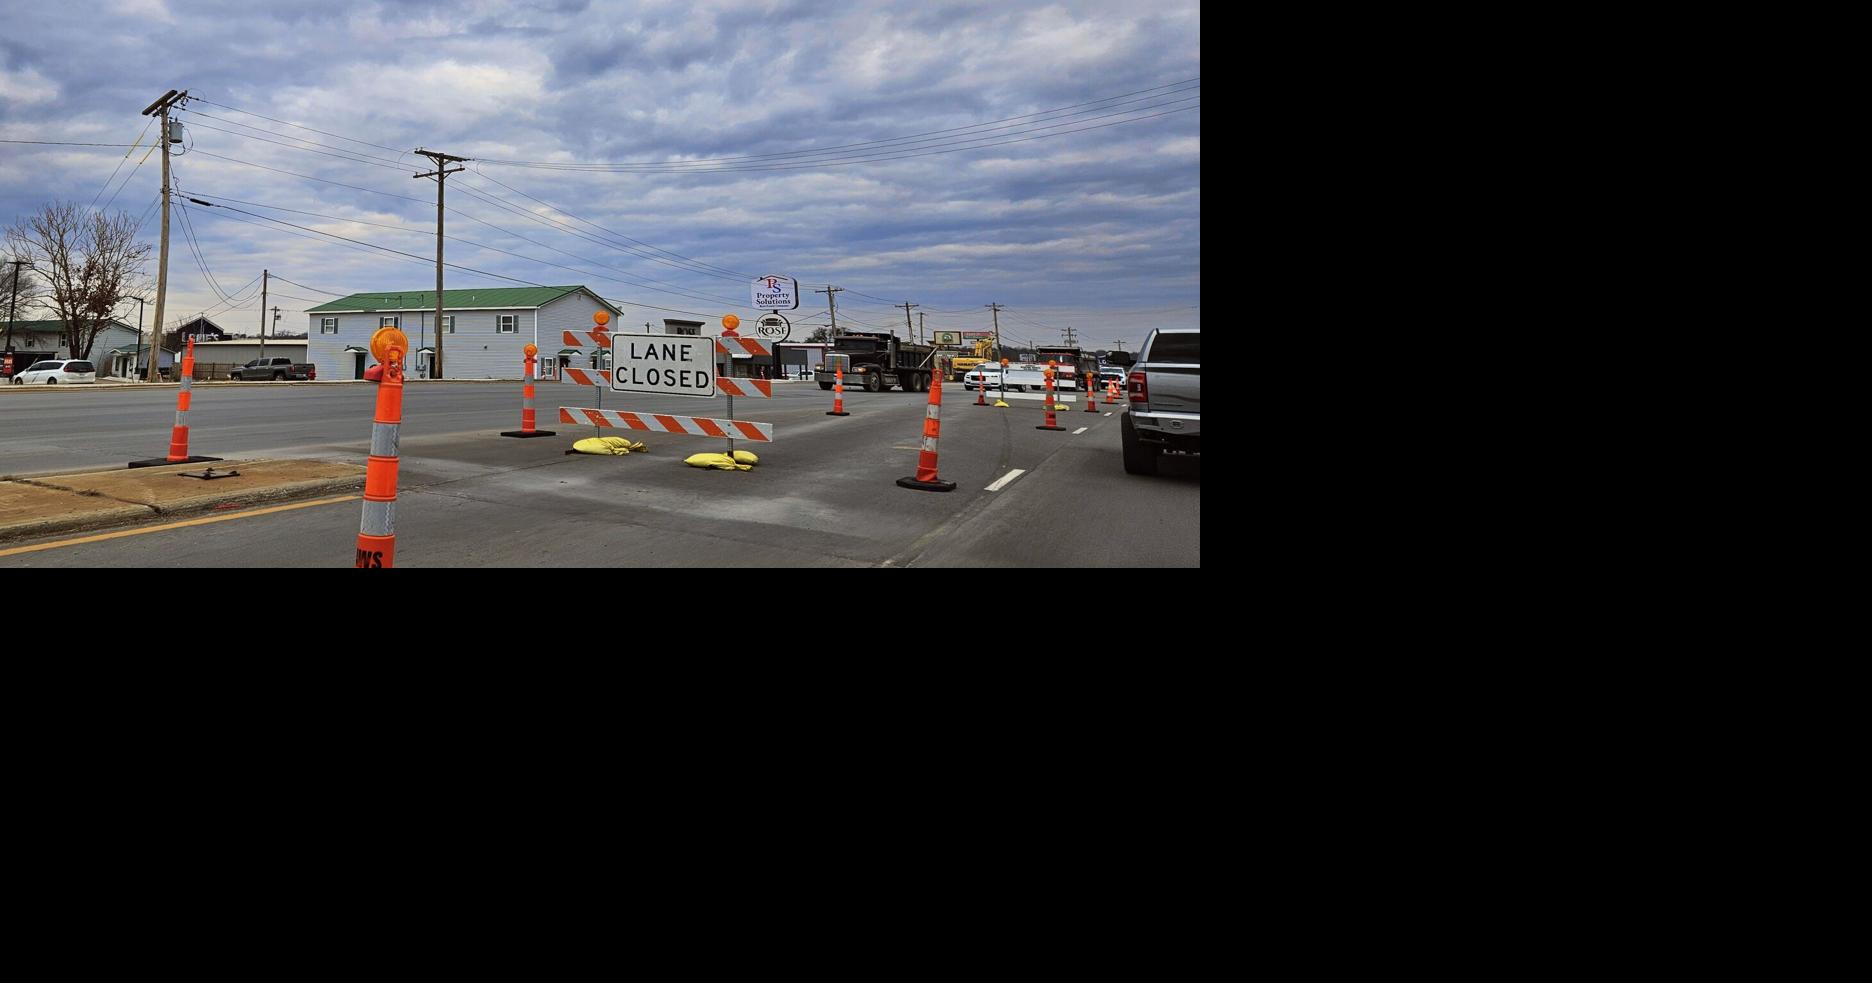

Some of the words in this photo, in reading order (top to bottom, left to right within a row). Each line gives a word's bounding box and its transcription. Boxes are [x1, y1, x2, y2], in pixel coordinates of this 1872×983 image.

[758, 327, 786, 336] ROSE
[630, 343, 693, 362] LANE
[616, 366, 709, 388] CLOSED
